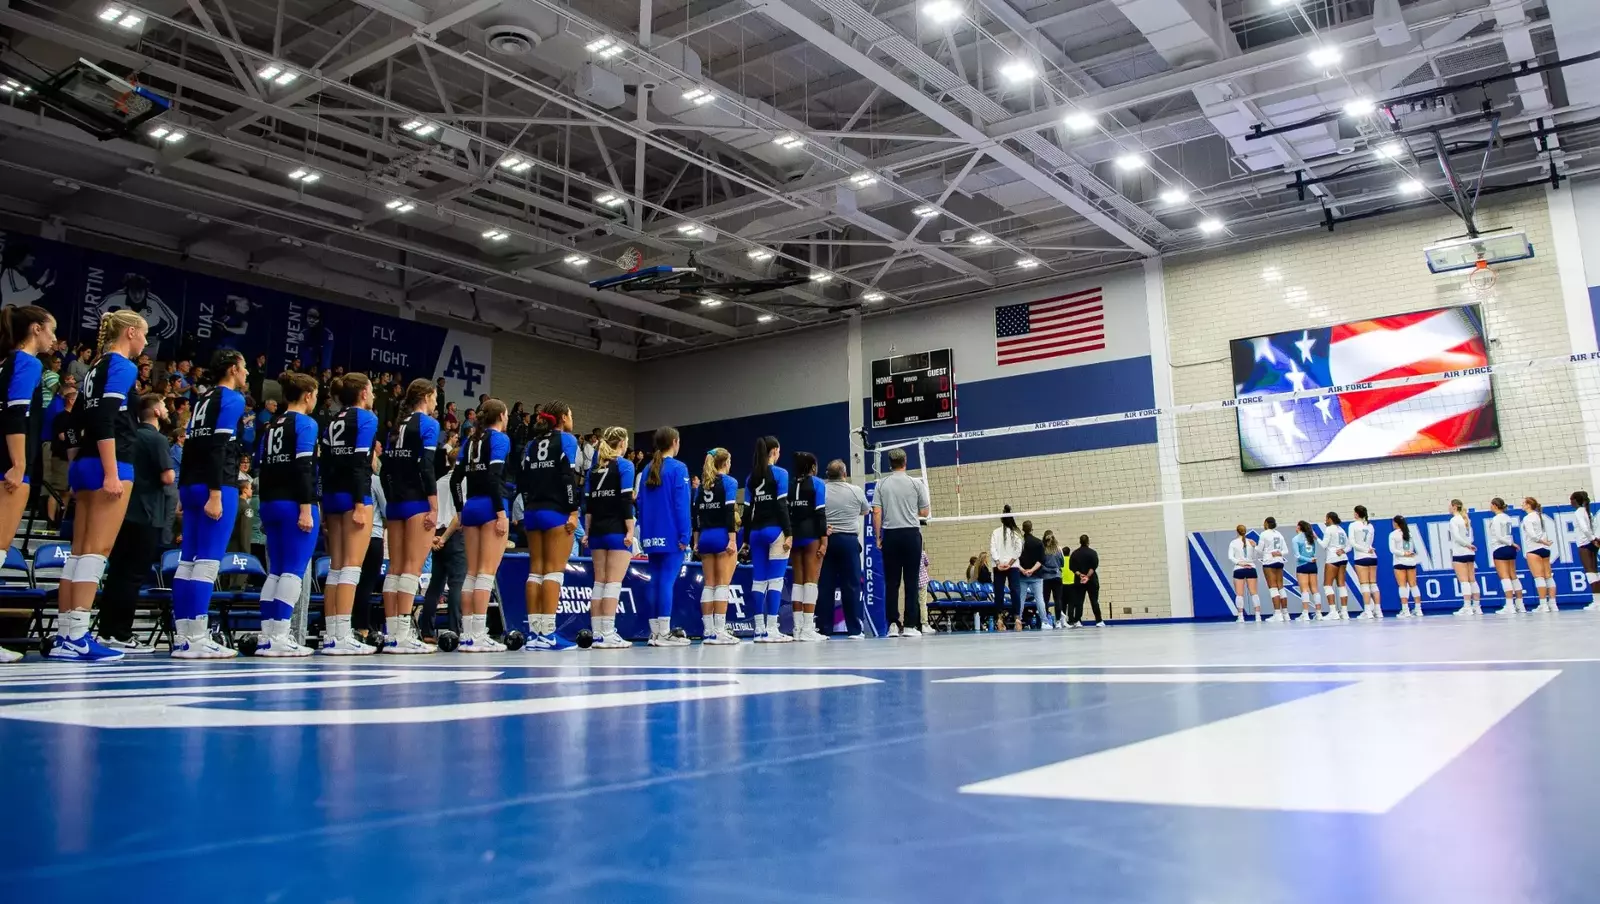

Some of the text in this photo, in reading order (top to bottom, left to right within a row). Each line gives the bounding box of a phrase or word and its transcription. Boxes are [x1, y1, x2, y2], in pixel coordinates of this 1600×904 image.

[81, 266, 104, 330] MARTIN
[197, 302, 214, 339] DIAZ
[372, 325, 397, 342] FLY.
[371, 348, 409, 367] FIGHT.
[1570, 354, 1587, 362] AIR
[443, 344, 486, 397] AF
[927, 368, 947, 377] GUEST
[1463, 366, 1492, 375] FORCE
[875, 376, 893, 385] HOME
[1346, 382, 1372, 390] FORCE
[1238, 396, 1263, 404] FORCE
[191, 398, 211, 429] 14
[267, 426, 284, 455] 13
[328, 419, 345, 447] 12
[537, 439, 550, 461] 8
[596, 468, 609, 490] 7
[233, 554, 248, 570] AF
[865, 544, 874, 605] FORCE
[556, 600, 625, 613] GRUMN
